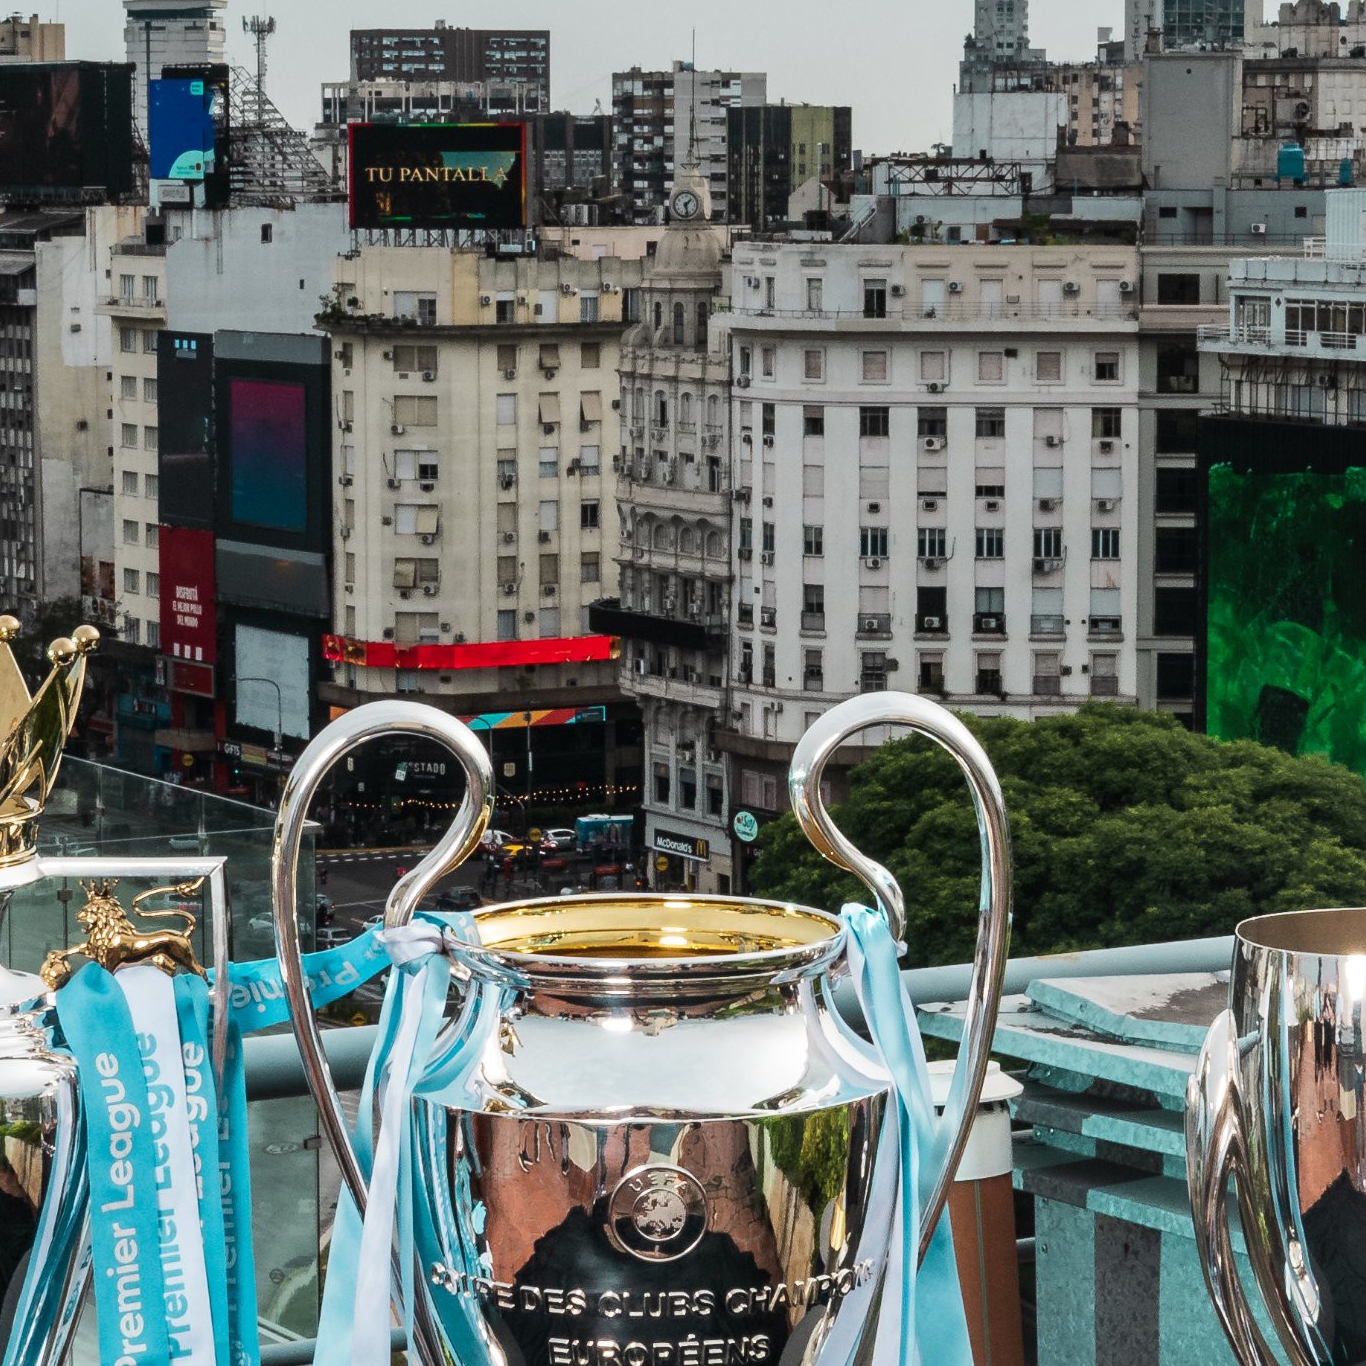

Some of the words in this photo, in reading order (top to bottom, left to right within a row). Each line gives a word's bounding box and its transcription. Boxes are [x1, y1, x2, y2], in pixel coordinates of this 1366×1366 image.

[365, 167, 393, 182] TU
[400, 167, 509, 182] PANTALLA
[657, 836, 692, 853] McDonald's
[94, 1051, 142, 1213] League
[519, 1285, 586, 1316] DES
[597, 1290, 717, 1319] CLUBS
